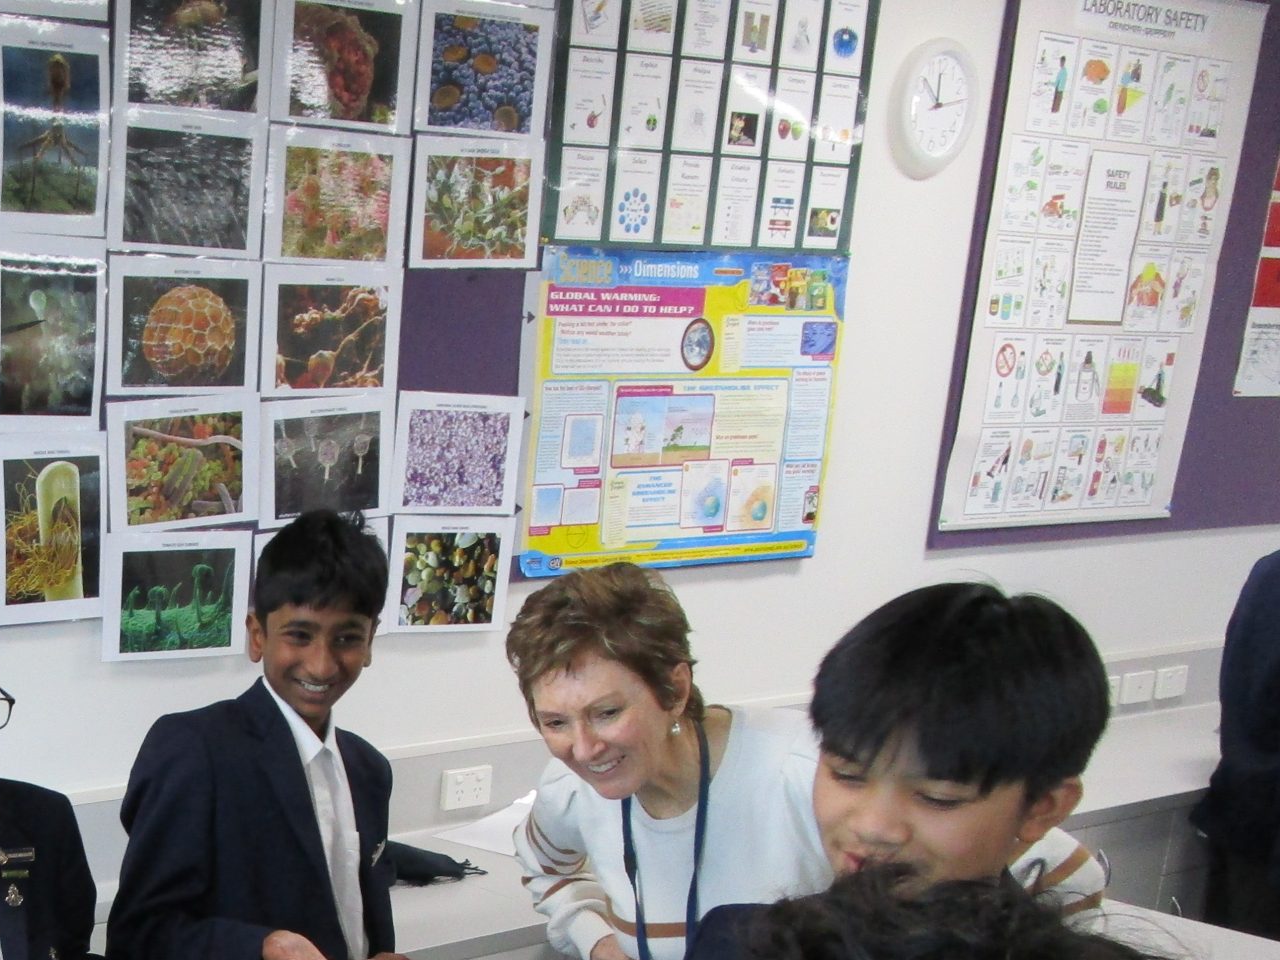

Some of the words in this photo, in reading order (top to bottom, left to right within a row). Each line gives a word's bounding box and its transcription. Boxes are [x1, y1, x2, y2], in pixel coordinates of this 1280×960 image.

[1084, 0, 1162, 23] LABORATORY
[1164, 8, 1209, 32] SAFETY
[1106, 168, 1131, 179] SAFETY
[559, 252, 613, 284] Science
[634, 260, 699, 279] Dimensions
[550, 292, 596, 301] GLOBAL
[601, 293, 661, 302] WARMING:
[549, 304, 584, 312] WHAT
[588, 304, 615, 313] CAN
[615, 305, 621, 313] I
[621, 305, 640, 313] DO
[642, 305, 658, 314] TO
[660, 306, 695, 314] HELP?
